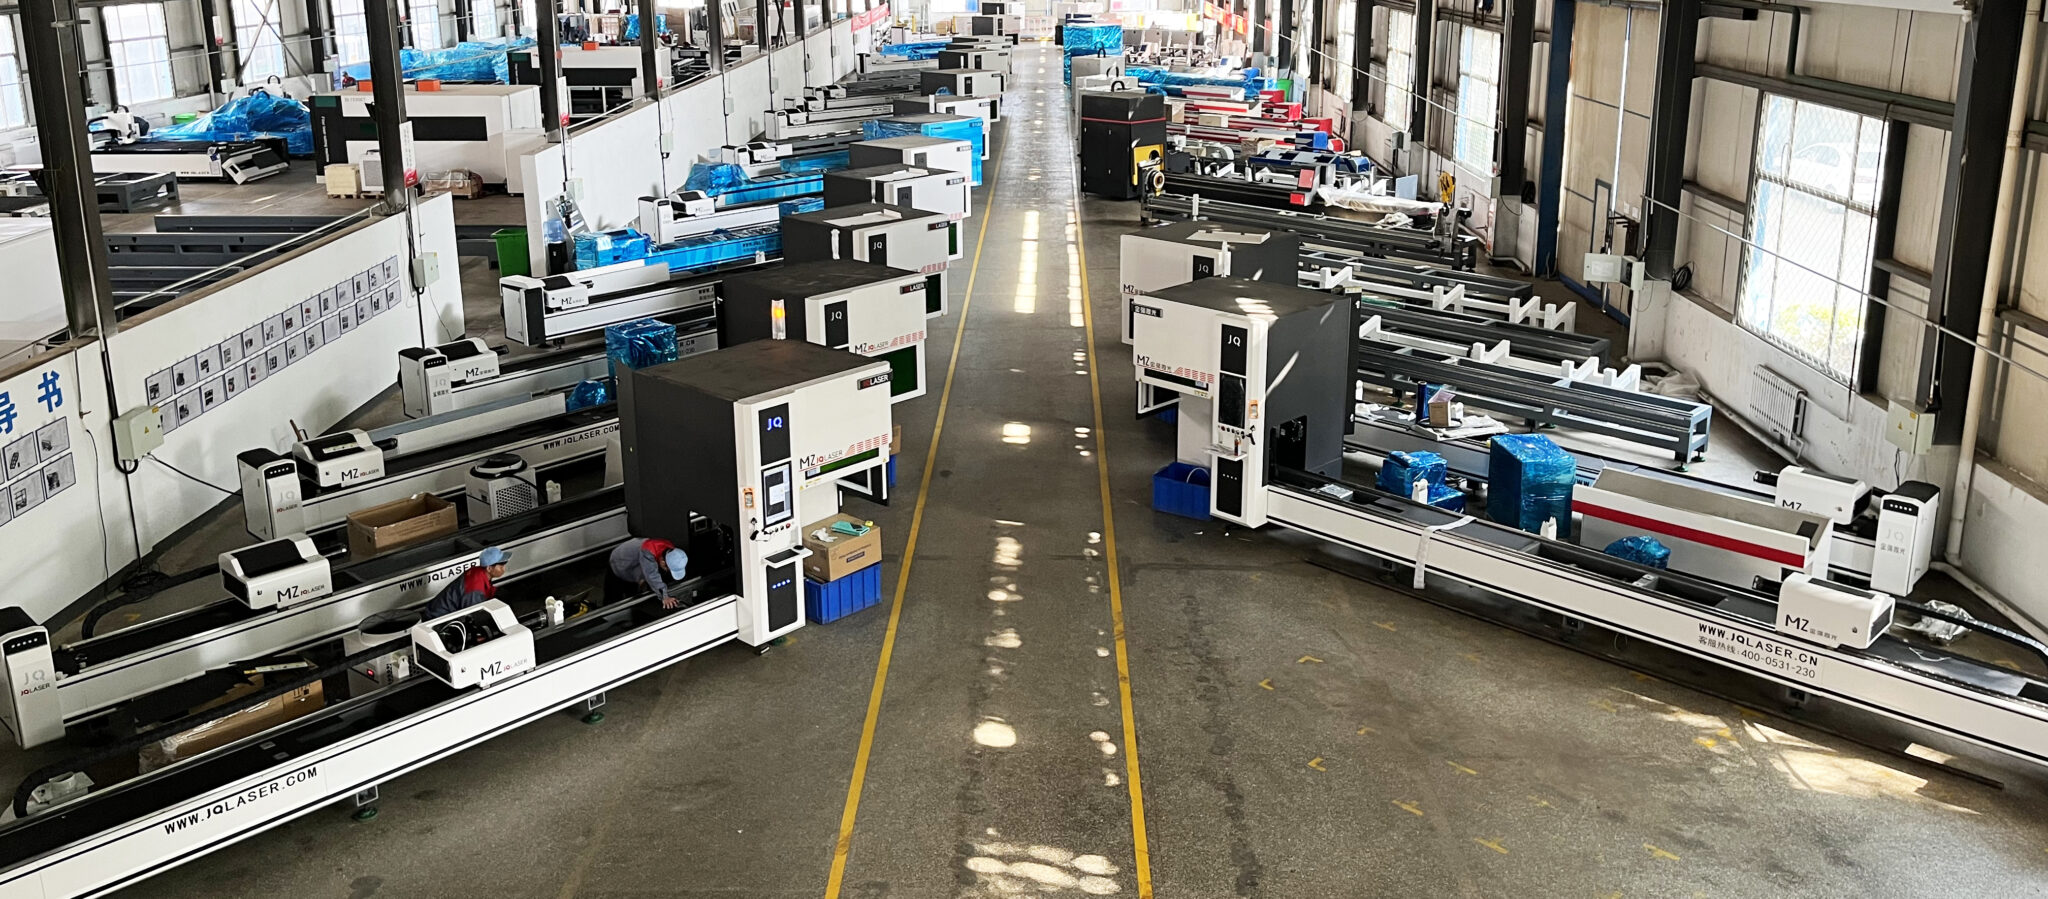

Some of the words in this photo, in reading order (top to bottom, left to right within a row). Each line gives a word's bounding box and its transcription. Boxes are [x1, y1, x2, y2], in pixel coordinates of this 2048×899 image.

[873, 241, 883, 250] JQ
[1198, 264, 1209, 273] JQ
[831, 311, 843, 321] JQ
[855, 342, 867, 354] MZ
[1227, 334, 1241, 347] JQ
[1137, 354, 1150, 366] MZ
[465, 367, 480, 378] MZ
[767, 416, 783, 431] JQ
[543, 424, 619, 450] WWW.JQLASER.COM
[800, 454, 815, 470] MZ
[341, 468, 359, 482] MZ
[277, 585, 299, 602] MZ
[1785, 614, 1809, 632] MZ
[1699, 622, 1818, 666] WWW.JQLASER.CN
[24, 669, 46, 686] JQ
[480, 661, 502, 680] MZ
[164, 766, 318, 835] WWW.JQLASER.COM
